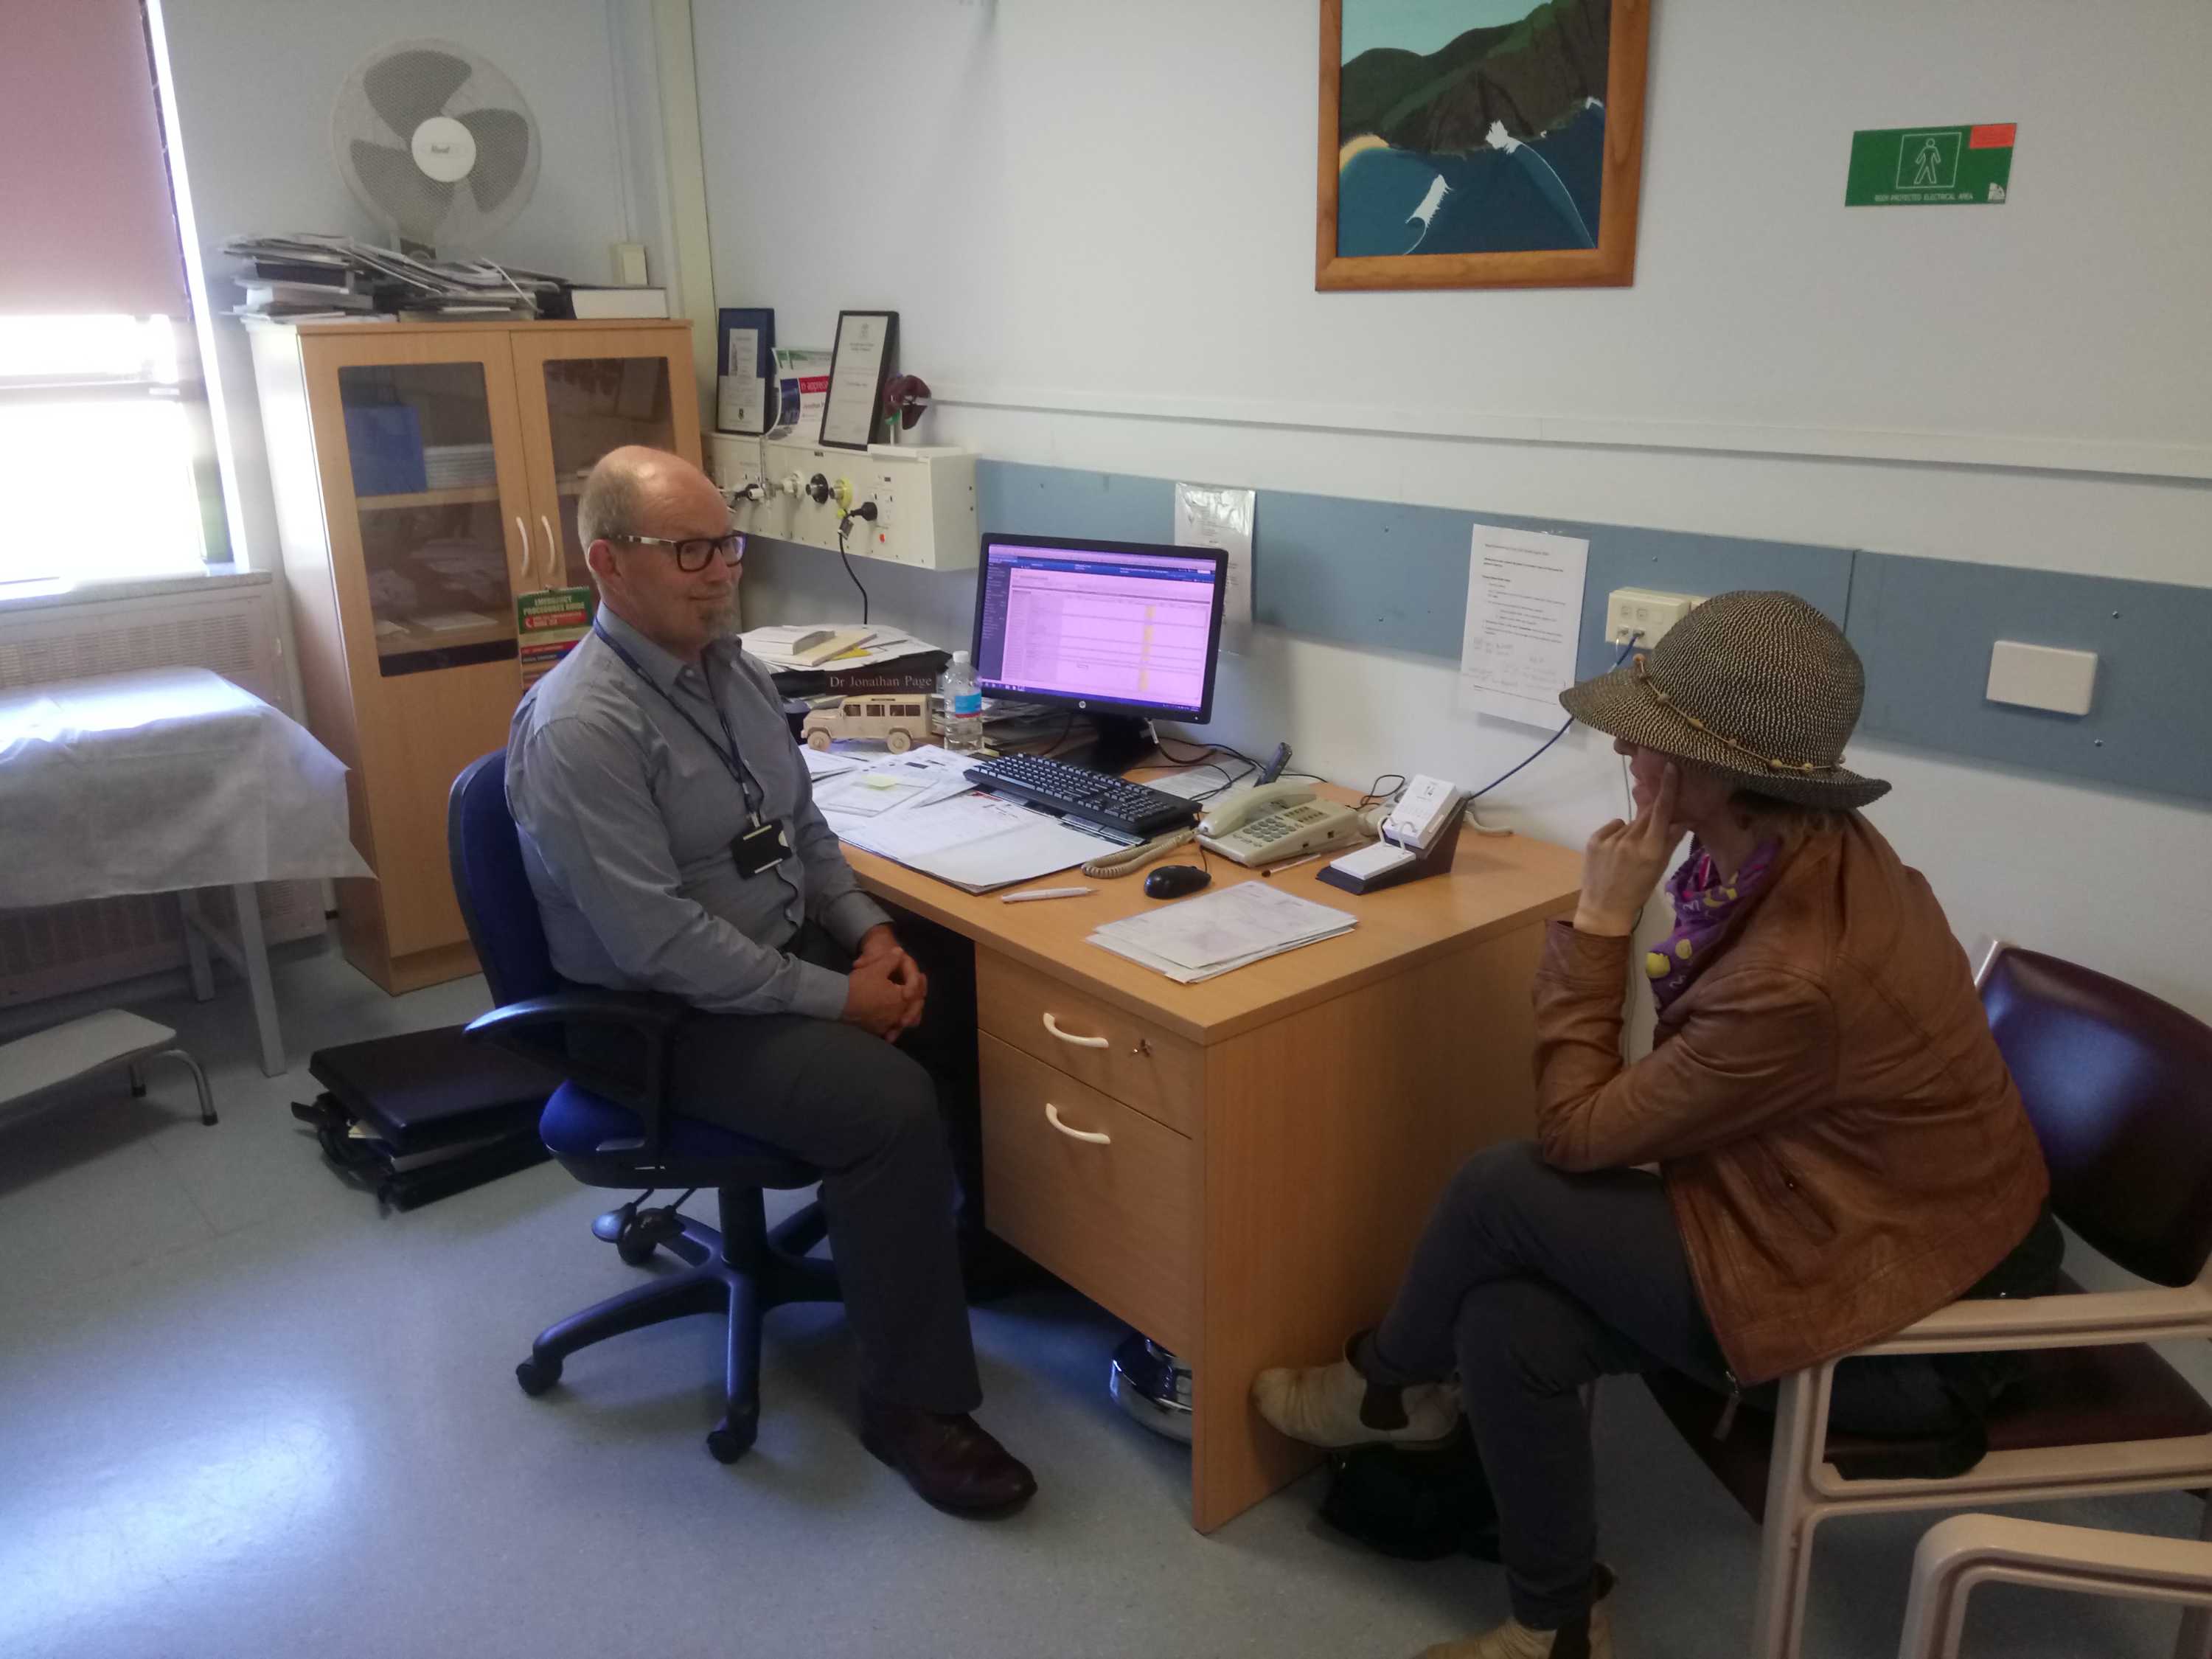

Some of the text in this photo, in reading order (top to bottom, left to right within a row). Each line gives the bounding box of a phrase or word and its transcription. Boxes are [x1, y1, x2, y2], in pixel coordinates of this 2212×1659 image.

[830, 675, 932, 689] Dr Jonathan Page
